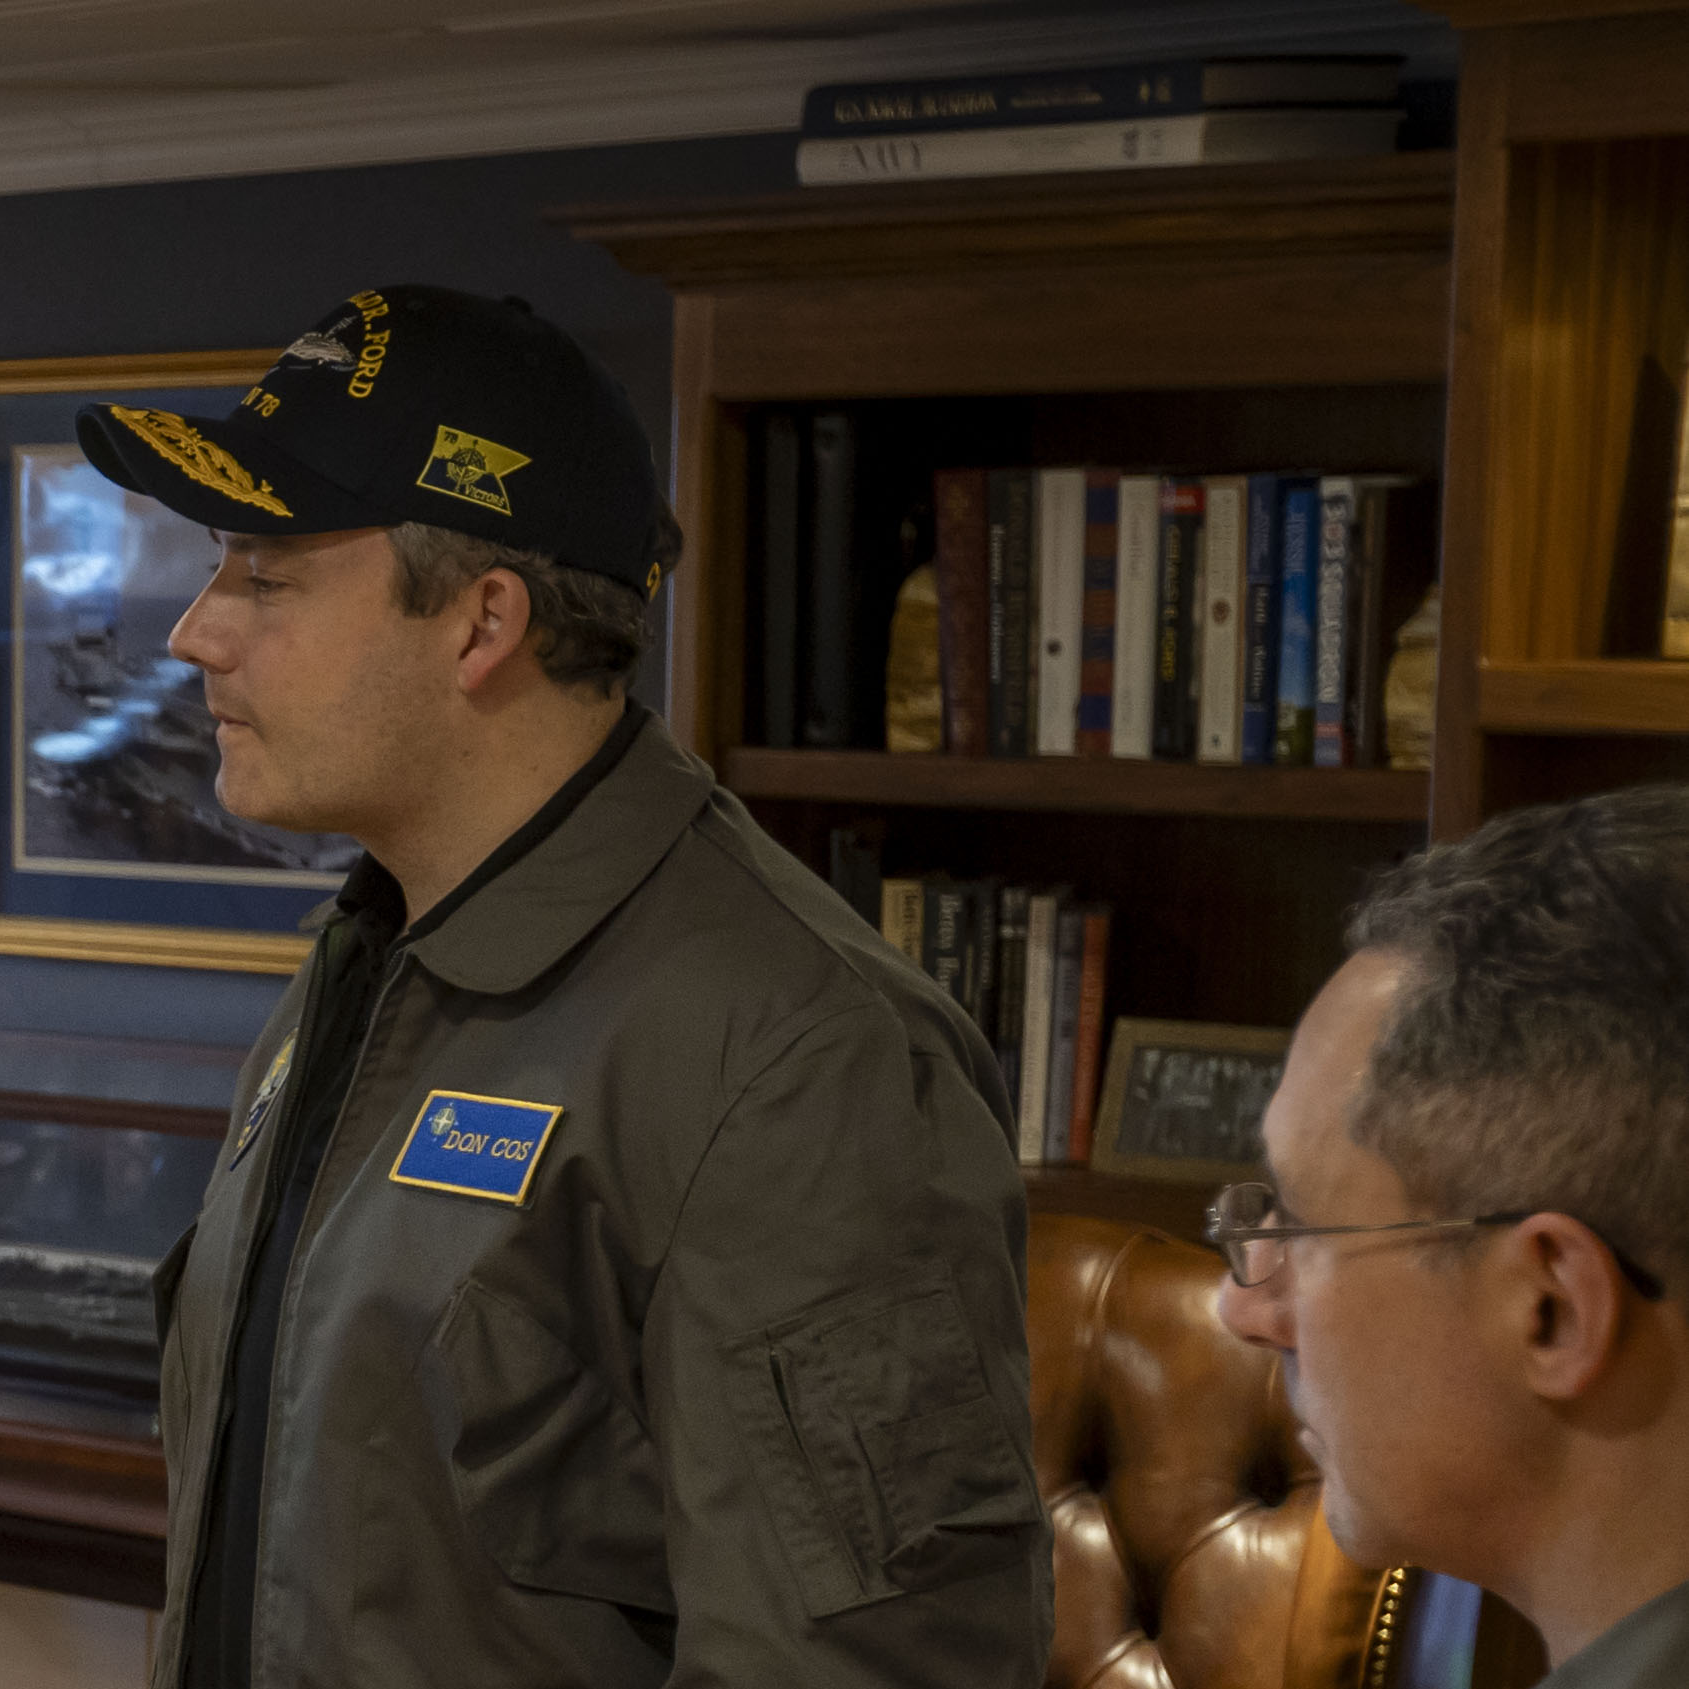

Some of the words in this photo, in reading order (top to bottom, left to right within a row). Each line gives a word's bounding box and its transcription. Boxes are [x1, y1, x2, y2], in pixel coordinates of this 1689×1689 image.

[348, 329, 391, 398] FORD
[442, 1130, 489, 1155] DON
[491, 1138, 534, 1161] COS
